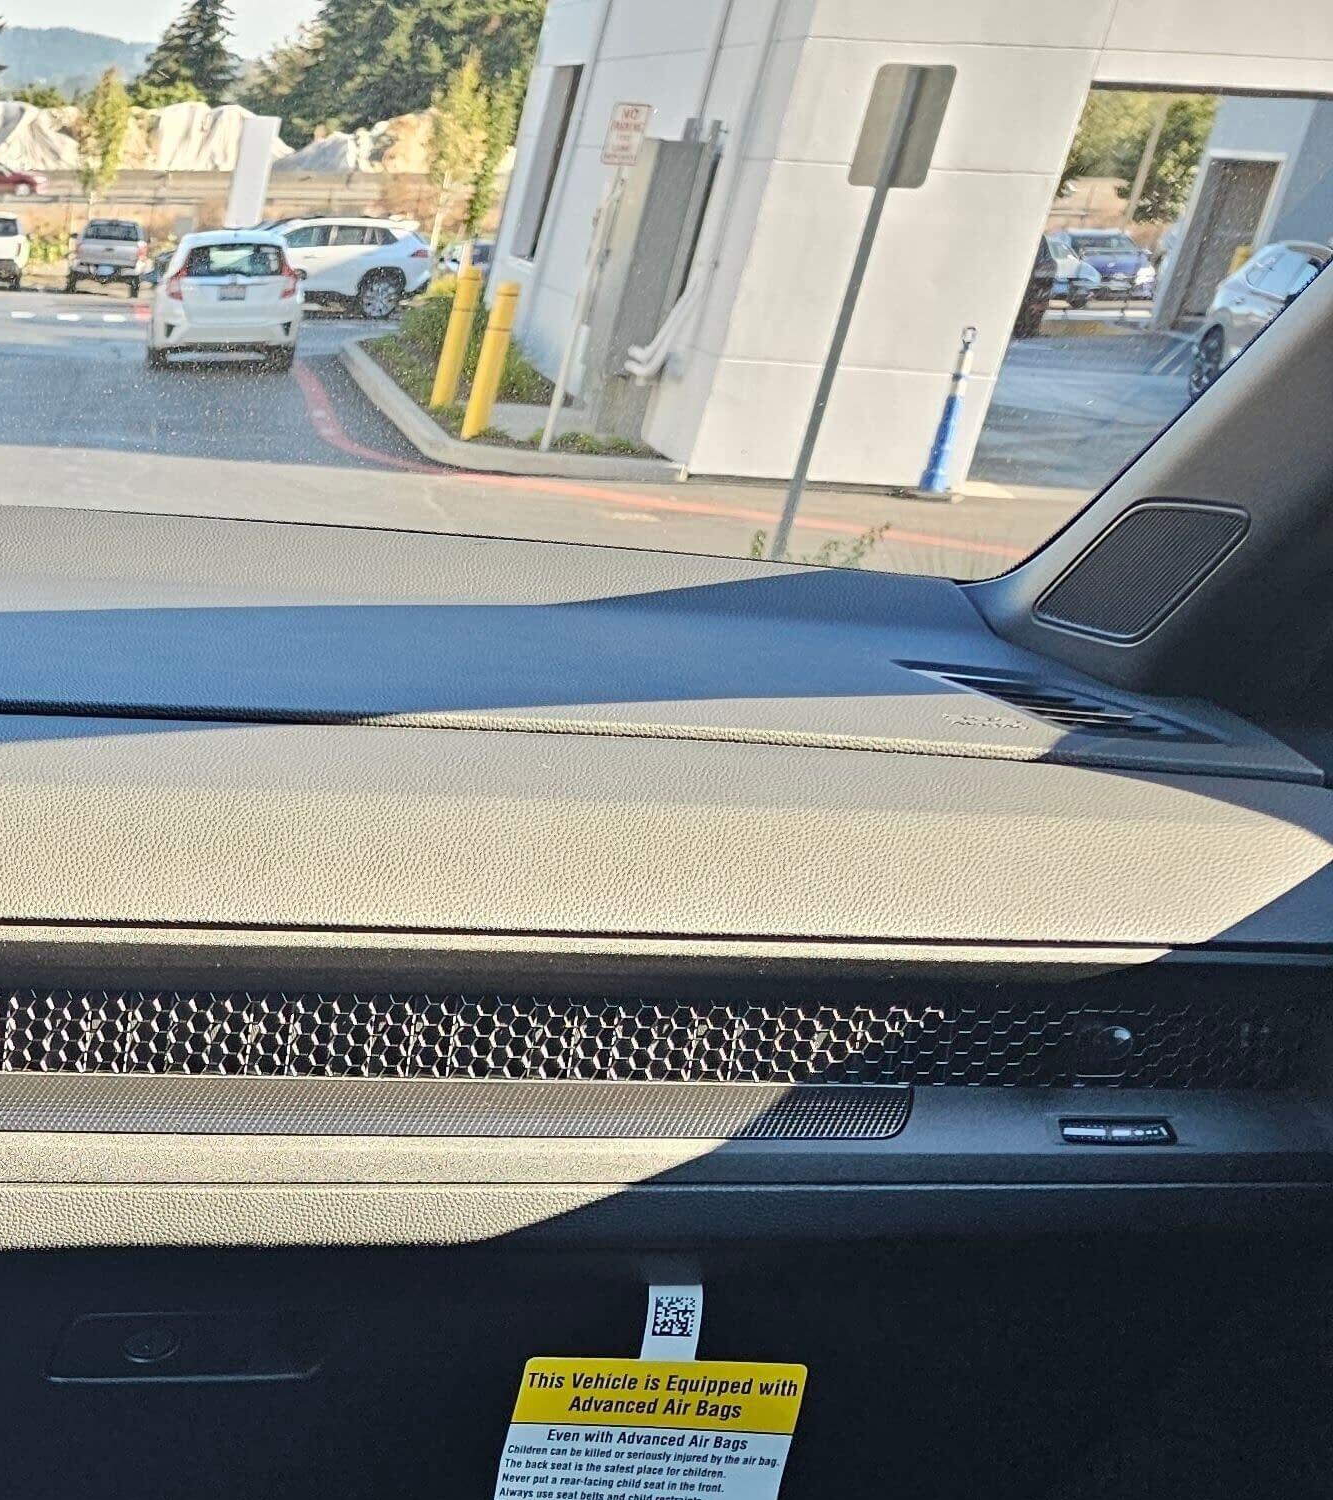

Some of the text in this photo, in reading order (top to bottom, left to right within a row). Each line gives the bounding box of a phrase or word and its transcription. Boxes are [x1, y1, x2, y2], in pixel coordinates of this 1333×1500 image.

[529, 1372, 798, 1397] This Vehicle is Equipped with
[568, 1396, 742, 1420] Advanced Air Bags
[547, 1429, 748, 1452] Even with Advanced Air Bags
[507, 1445, 780, 1468] Children can be killed or seriously injured by the air bag.
[505, 1458, 727, 1479] The back seat is the safest place for children.
[499, 1487, 534, 1499] Always
[536, 1490, 554, 1499] use
[556, 1490, 578, 1500] seat
[580, 1491, 604, 1500] belts
[502, 1473, 724, 1493] Never put a rear-facing child seat in the front.
